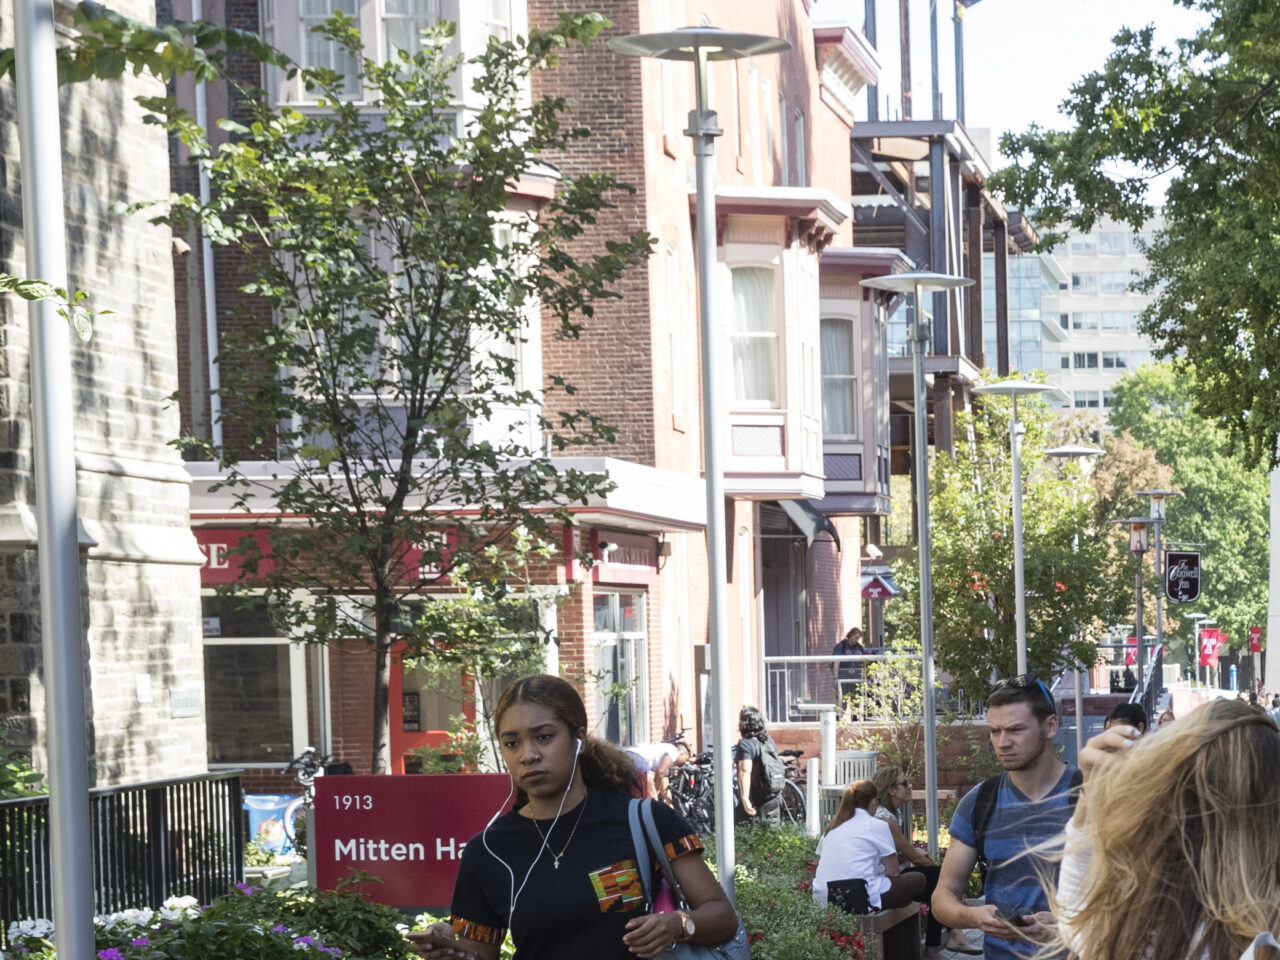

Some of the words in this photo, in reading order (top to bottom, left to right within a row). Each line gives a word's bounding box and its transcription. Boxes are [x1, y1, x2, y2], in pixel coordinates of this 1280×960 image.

[1203, 638, 1217, 655] T
[333, 794, 373, 811] 1913
[334, 837, 425, 862] Mitten
